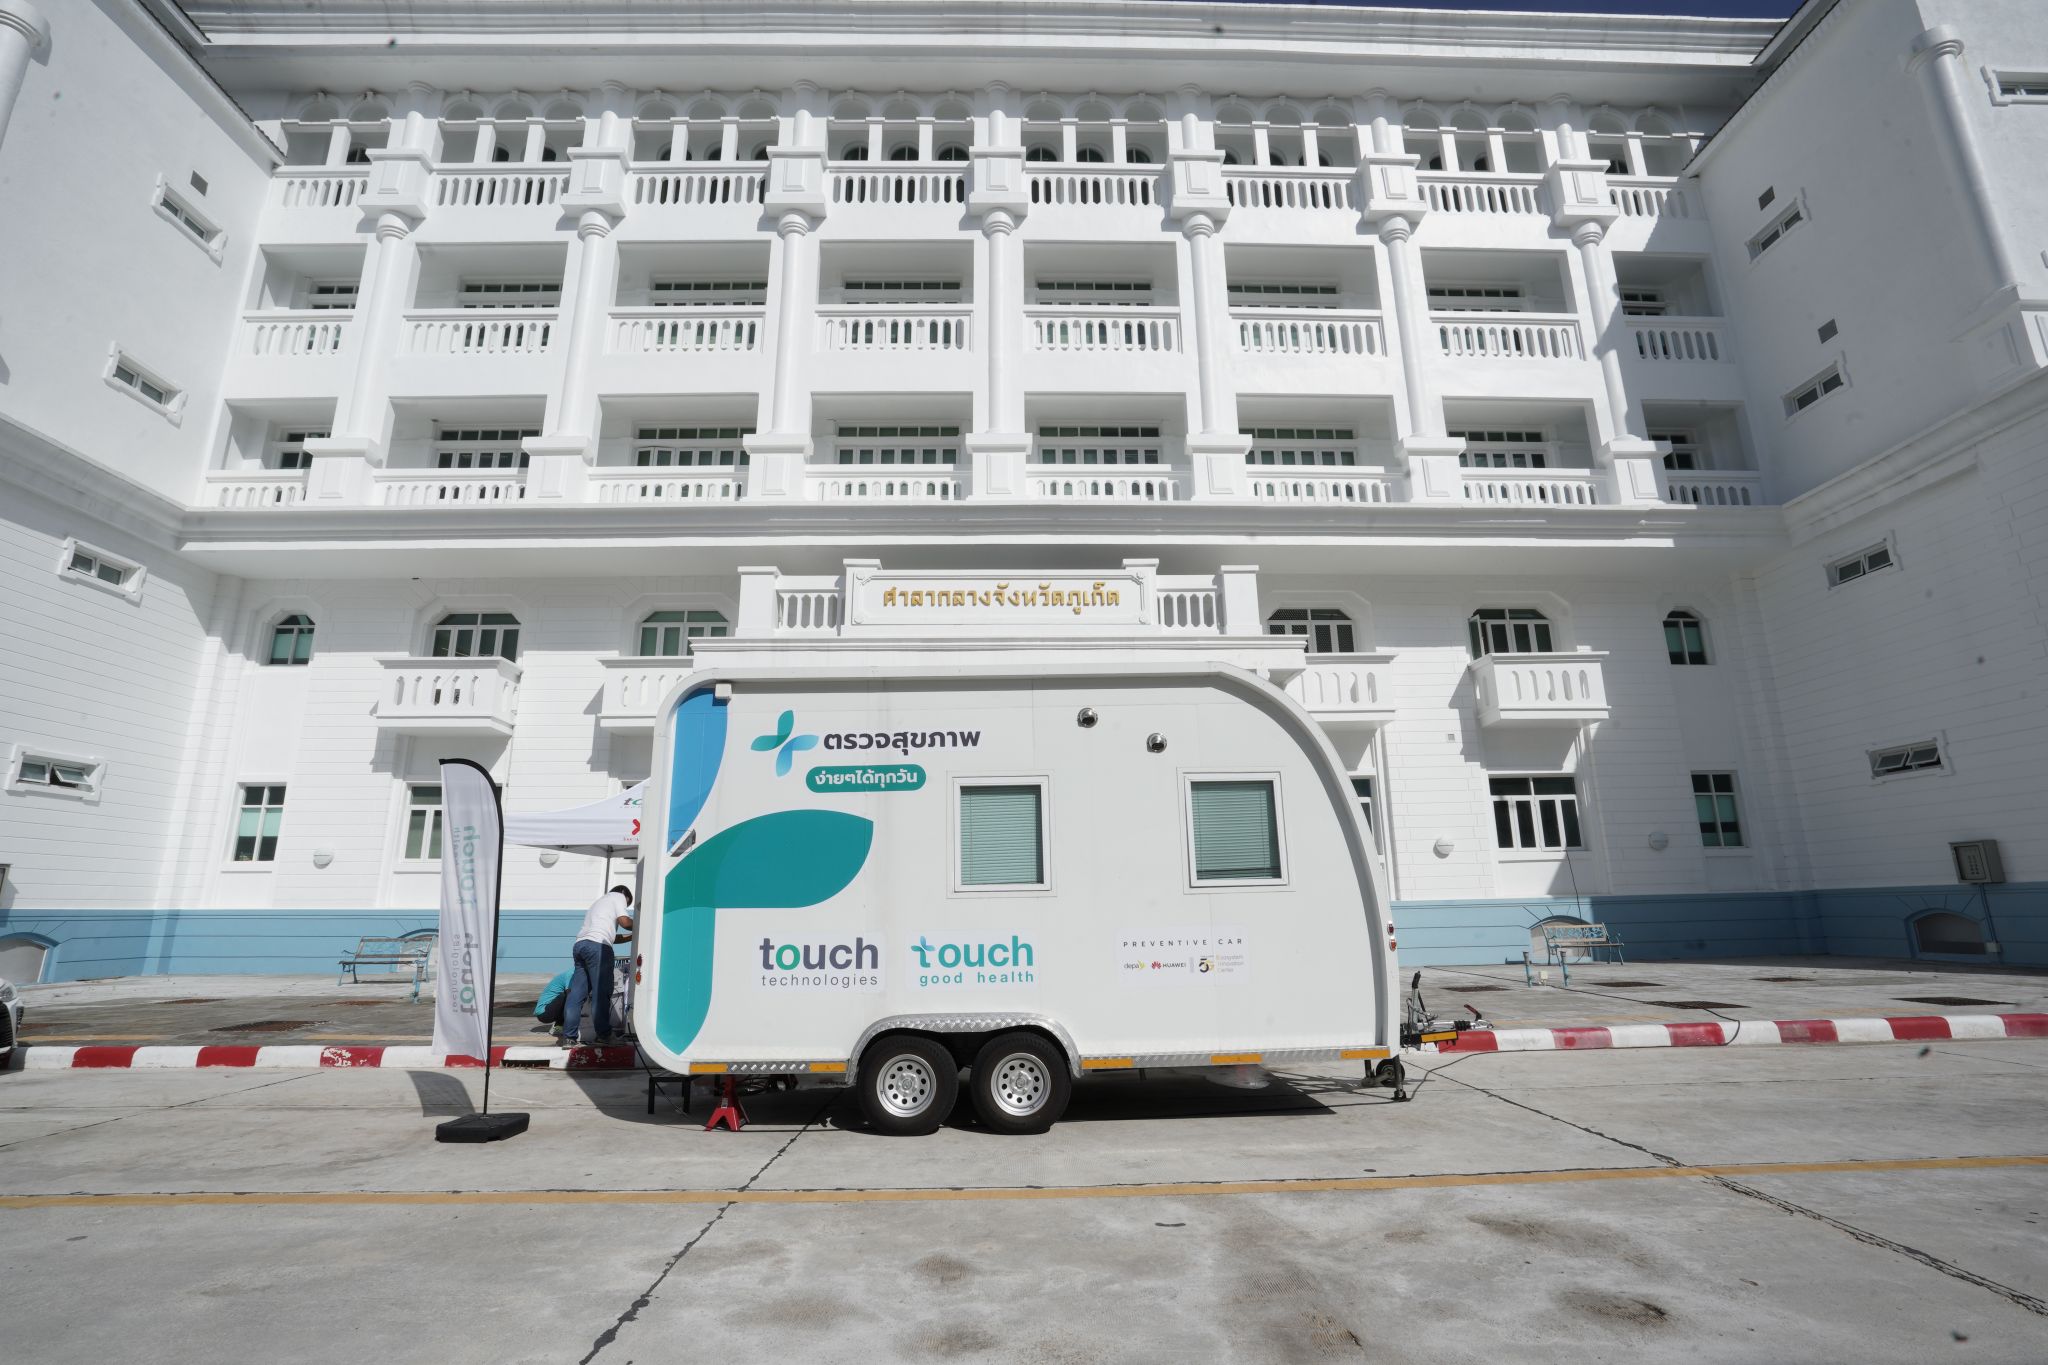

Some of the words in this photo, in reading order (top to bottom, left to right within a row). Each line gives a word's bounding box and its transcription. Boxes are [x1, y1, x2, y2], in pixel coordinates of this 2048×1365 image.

[883, 581, 1120, 615] ศาลากลางจังหวัดภูเก็ต
[823, 730, 981, 756] ตรวจสุขภาพ
[815, 768, 918, 788] ง่ายๆได้ทุกวัน
[759, 937, 879, 971] touch
[910, 935, 1034, 969] touch
[1123, 939, 1207, 948] PREVENTIVE
[762, 973, 879, 988] technologies
[919, 972, 963, 987] good
[977, 970, 1034, 984] health
